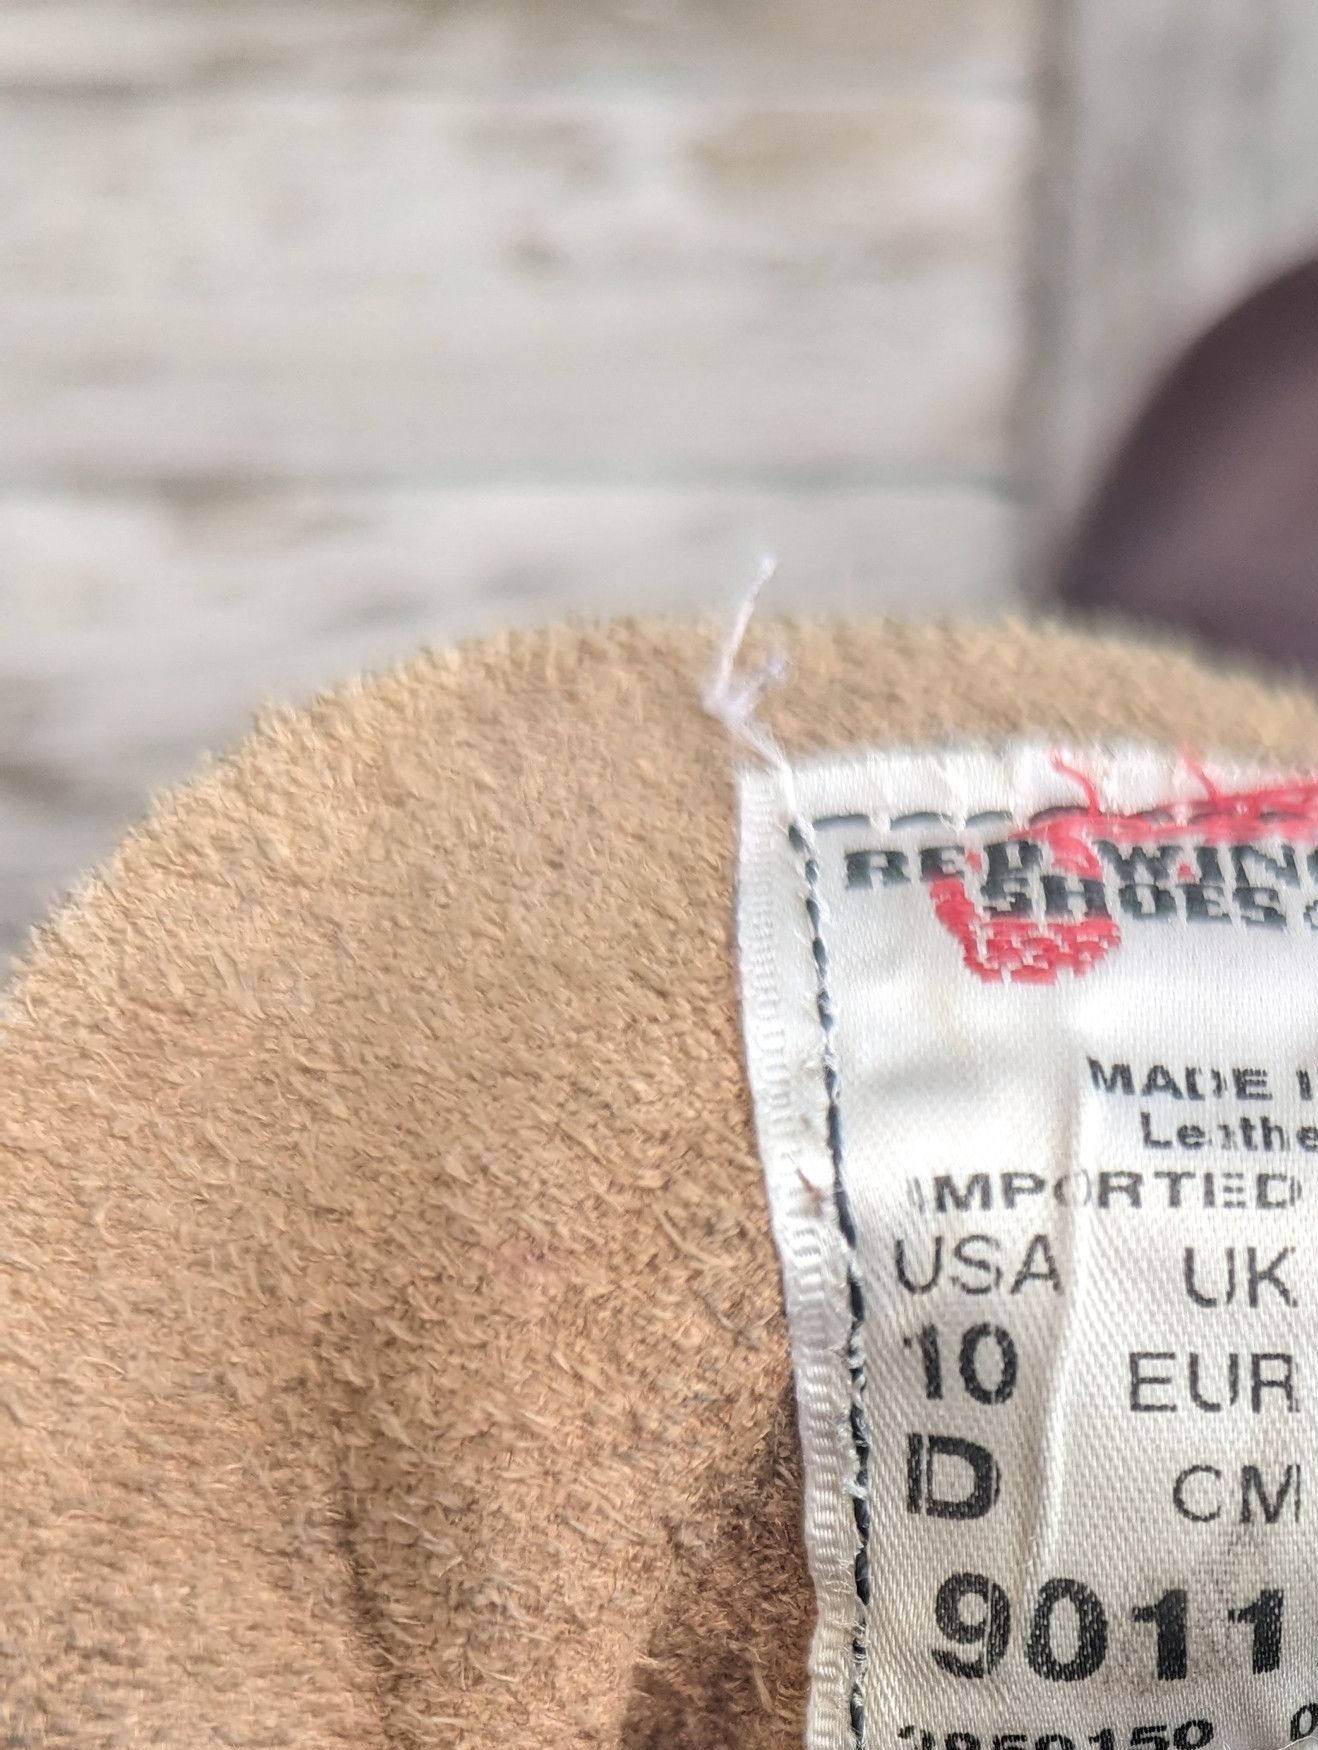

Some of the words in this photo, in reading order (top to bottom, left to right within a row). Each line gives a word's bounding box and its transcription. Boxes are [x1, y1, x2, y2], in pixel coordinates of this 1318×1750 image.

[843, 840, 1043, 890] RED
[1086, 1056, 1274, 1100] MADE
[893, 1233, 1063, 1298] USA
[1182, 1245, 1299, 1309] UK
[903, 1321, 1021, 1407] 10
[1128, 1351, 1302, 1415] EUR
[905, 1432, 1001, 1522] D
[1173, 1463, 1302, 1525] CM
[930, 1571, 1286, 1684] 9011
